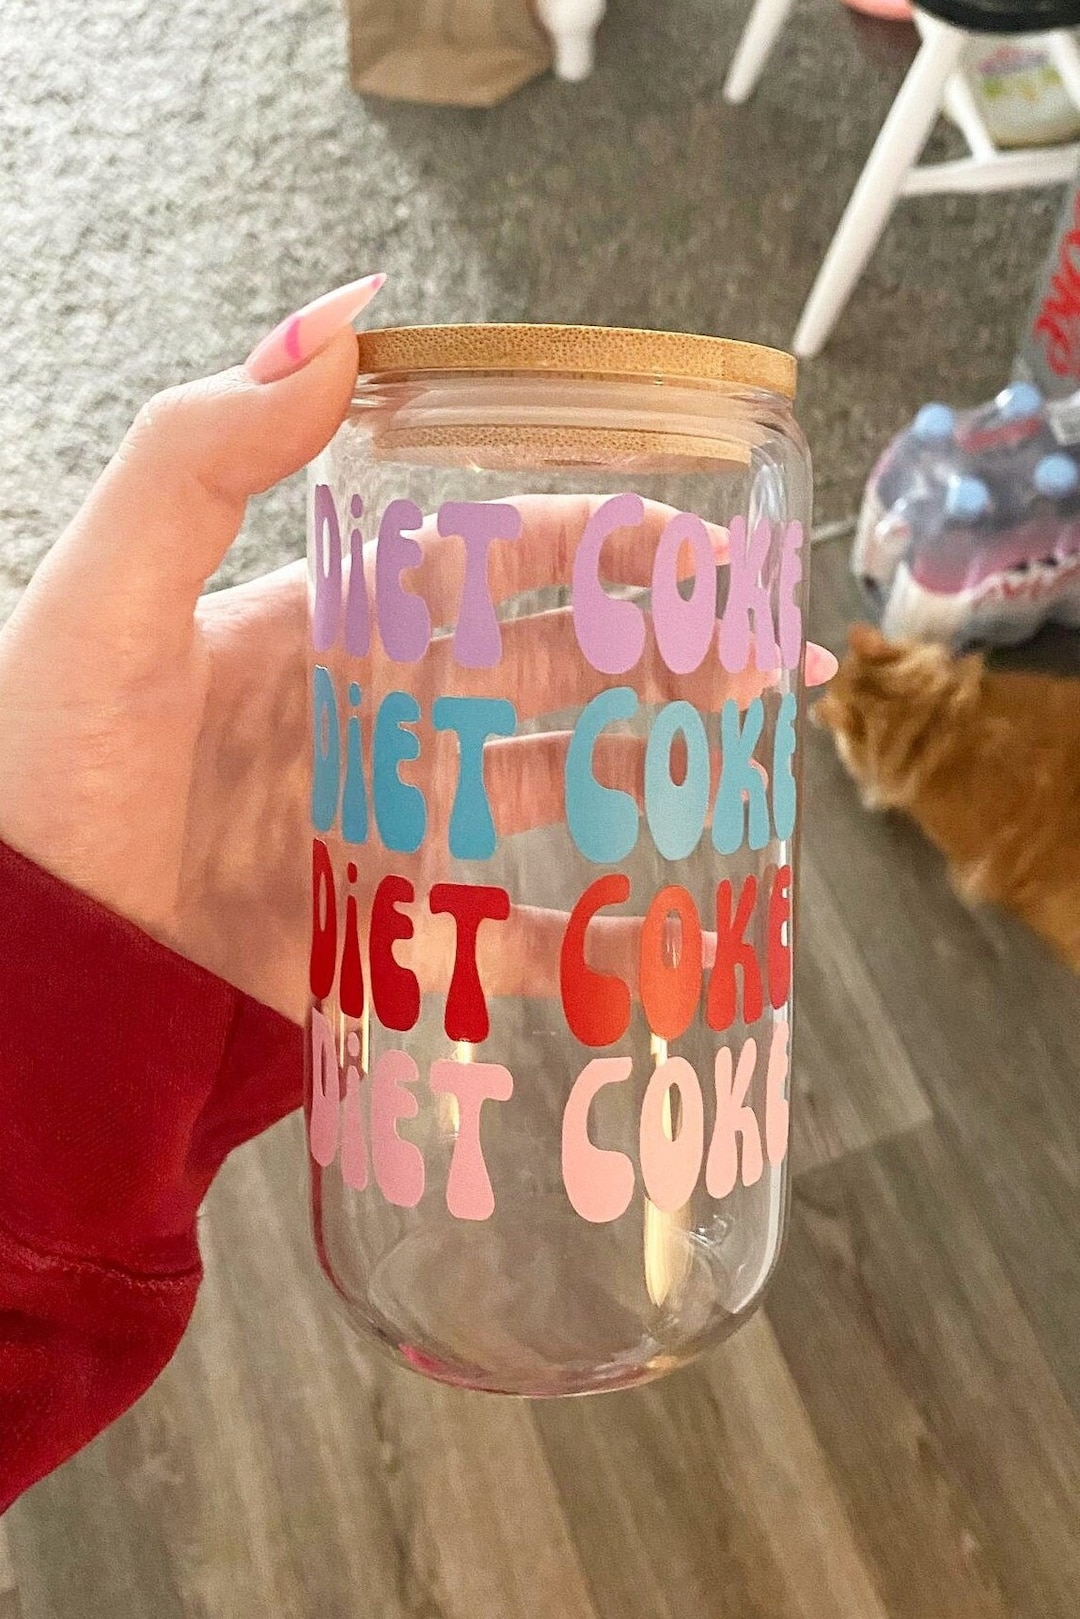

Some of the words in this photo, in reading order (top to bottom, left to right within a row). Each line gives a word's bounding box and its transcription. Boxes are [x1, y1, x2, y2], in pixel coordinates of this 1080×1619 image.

[572, 492, 803, 675] COKE
[565, 686, 797, 864] COKE
[560, 864, 792, 1048] COKE
